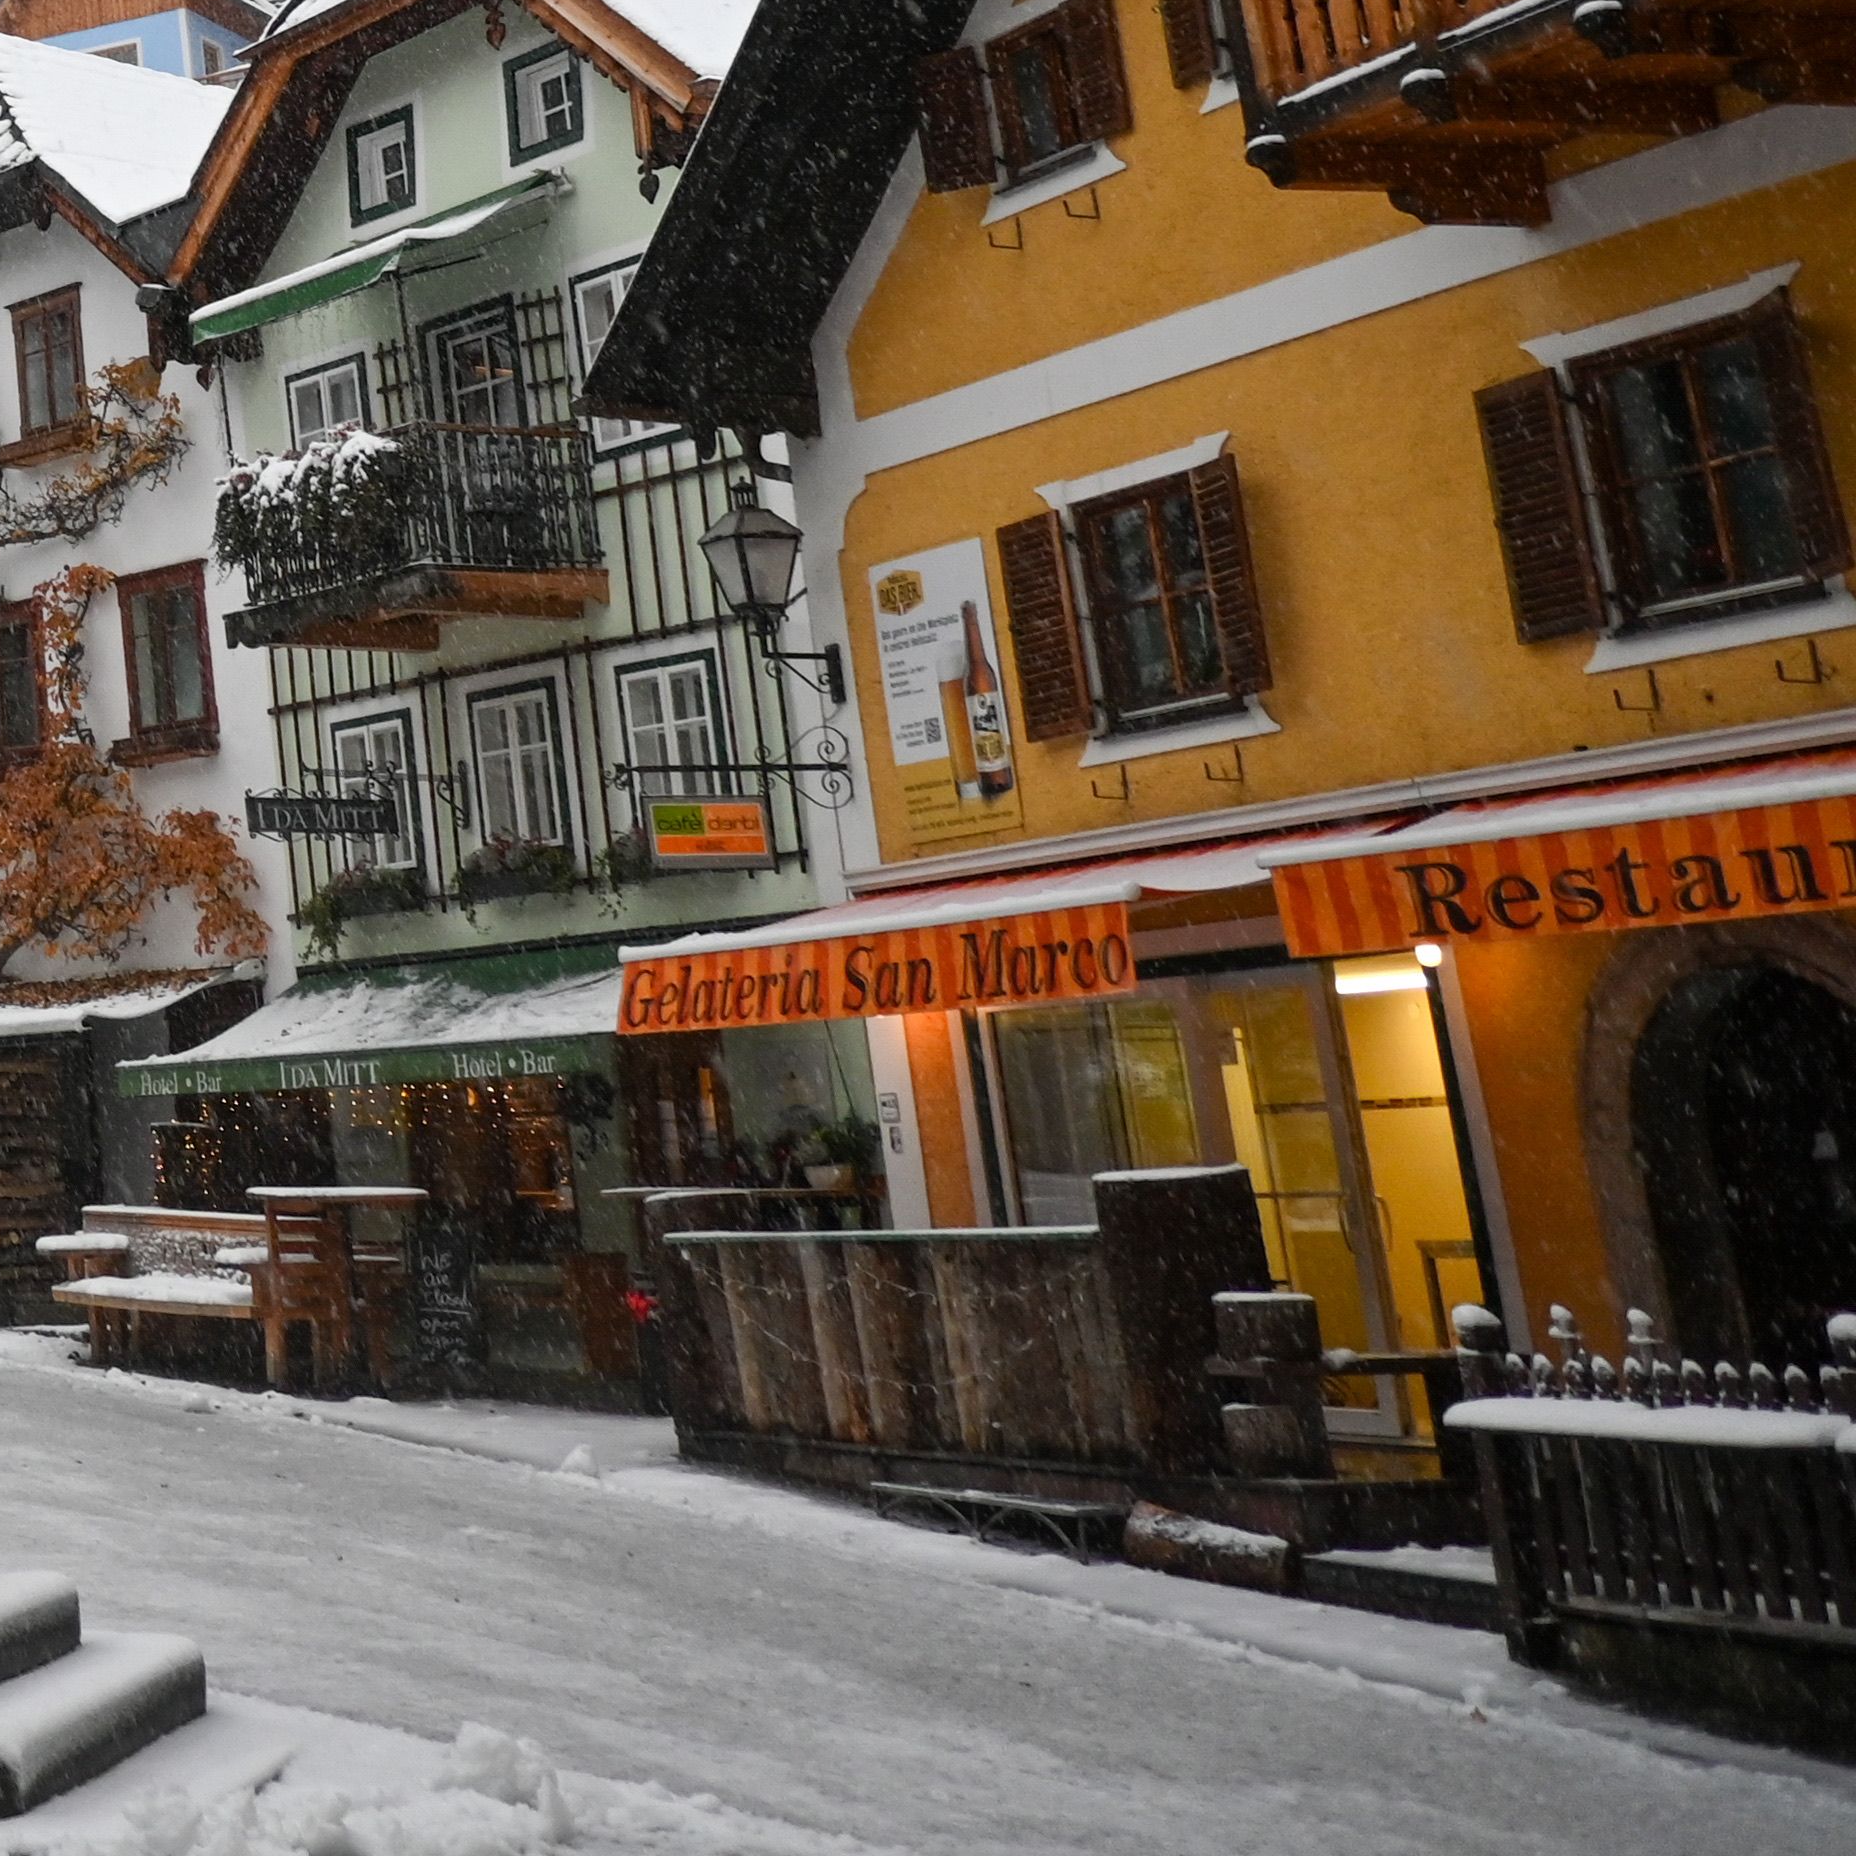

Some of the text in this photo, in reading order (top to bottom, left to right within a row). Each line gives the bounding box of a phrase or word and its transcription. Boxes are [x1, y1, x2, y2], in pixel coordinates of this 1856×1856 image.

[257, 802, 386, 830] IDA MITT
[625, 931, 1130, 1028] Gelateria San Marco
[279, 1057, 381, 1090] IDA MITT
[451, 1048, 556, 1079] Hotel Bar
[140, 1070, 222, 1096] Hotel Bar
